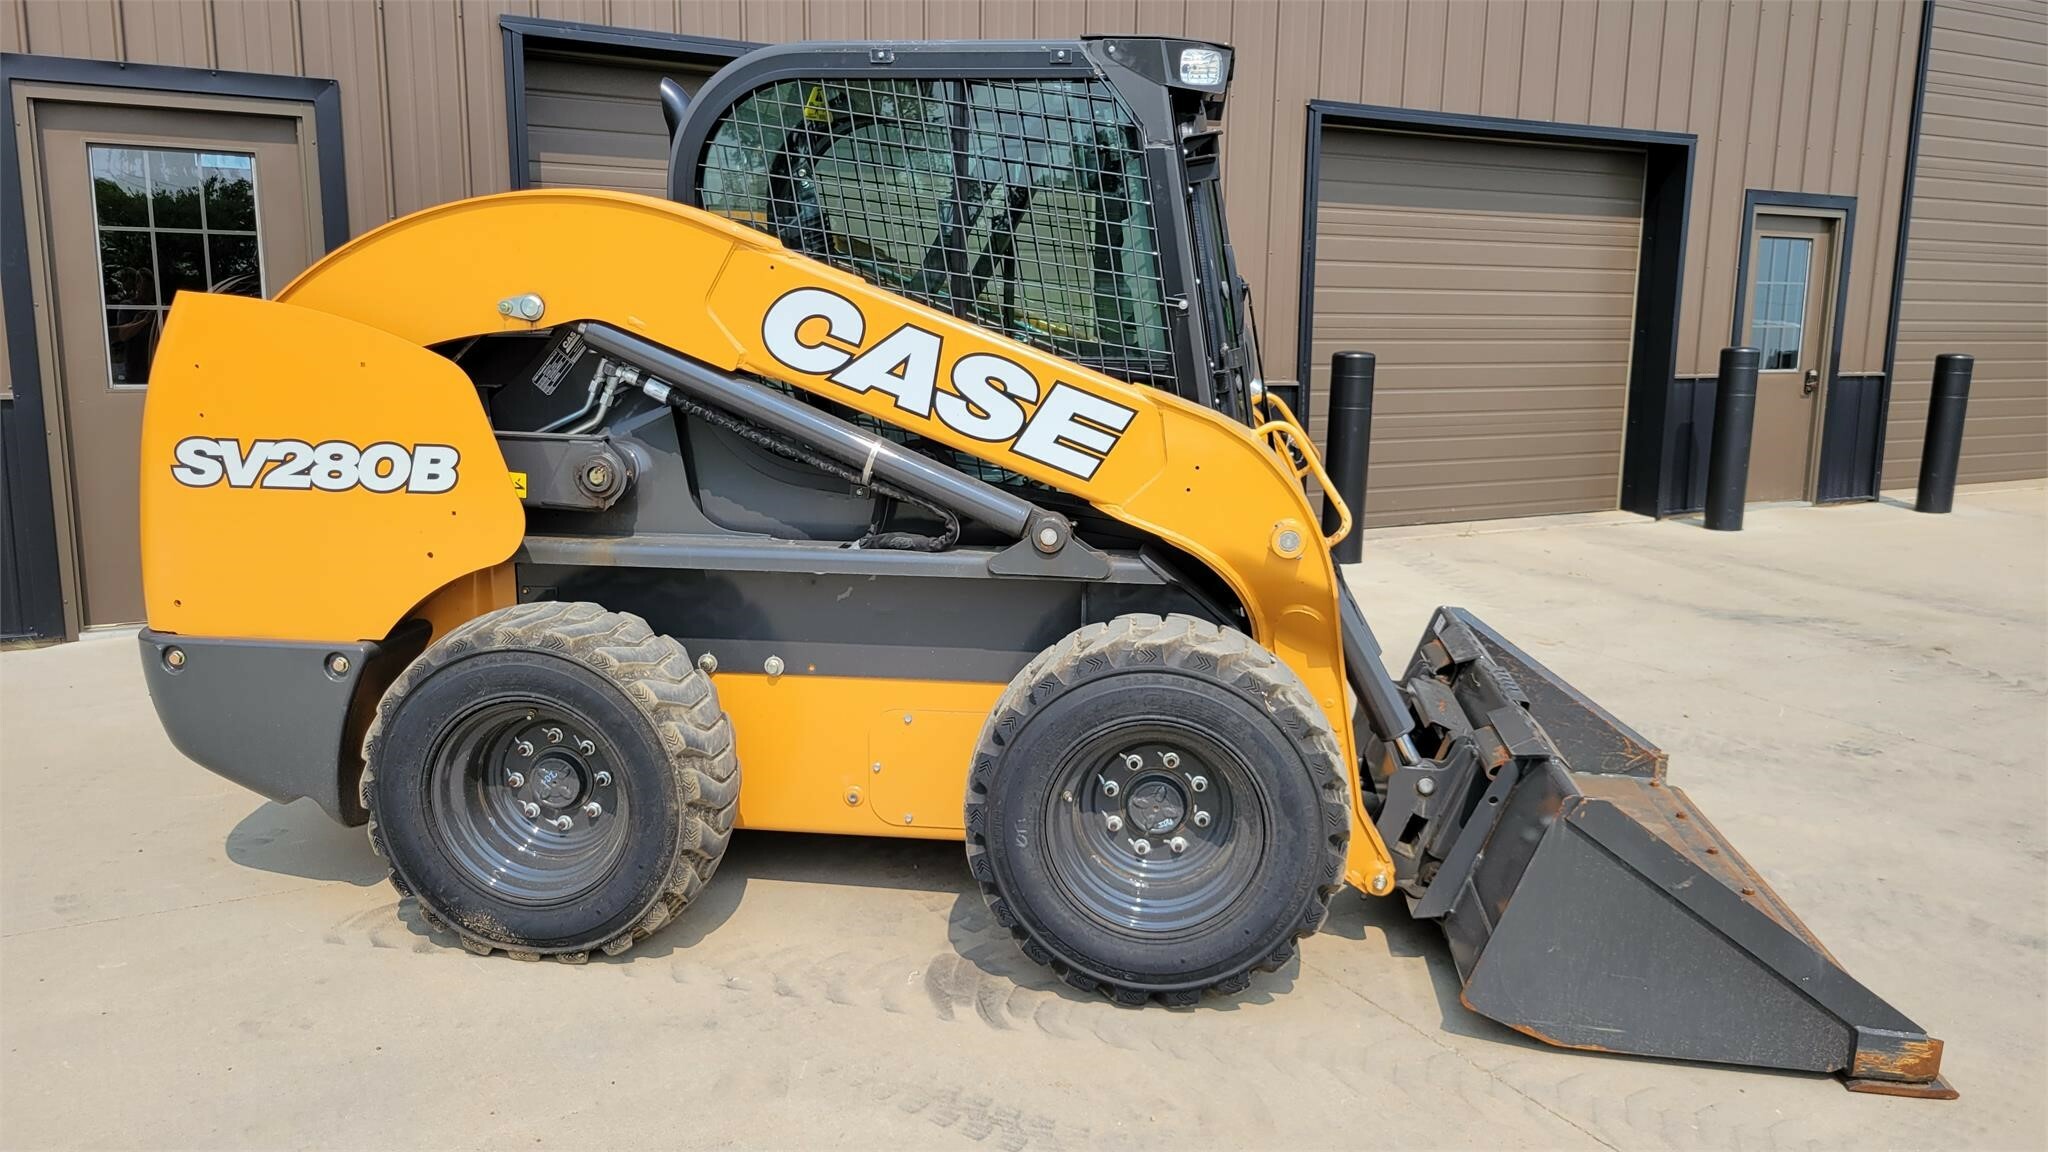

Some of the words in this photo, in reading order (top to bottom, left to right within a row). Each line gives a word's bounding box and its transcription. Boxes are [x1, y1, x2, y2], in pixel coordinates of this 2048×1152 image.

[562, 331, 578, 349] CAS
[761, 286, 1139, 482] CASE
[170, 436, 460, 494] SV280B
